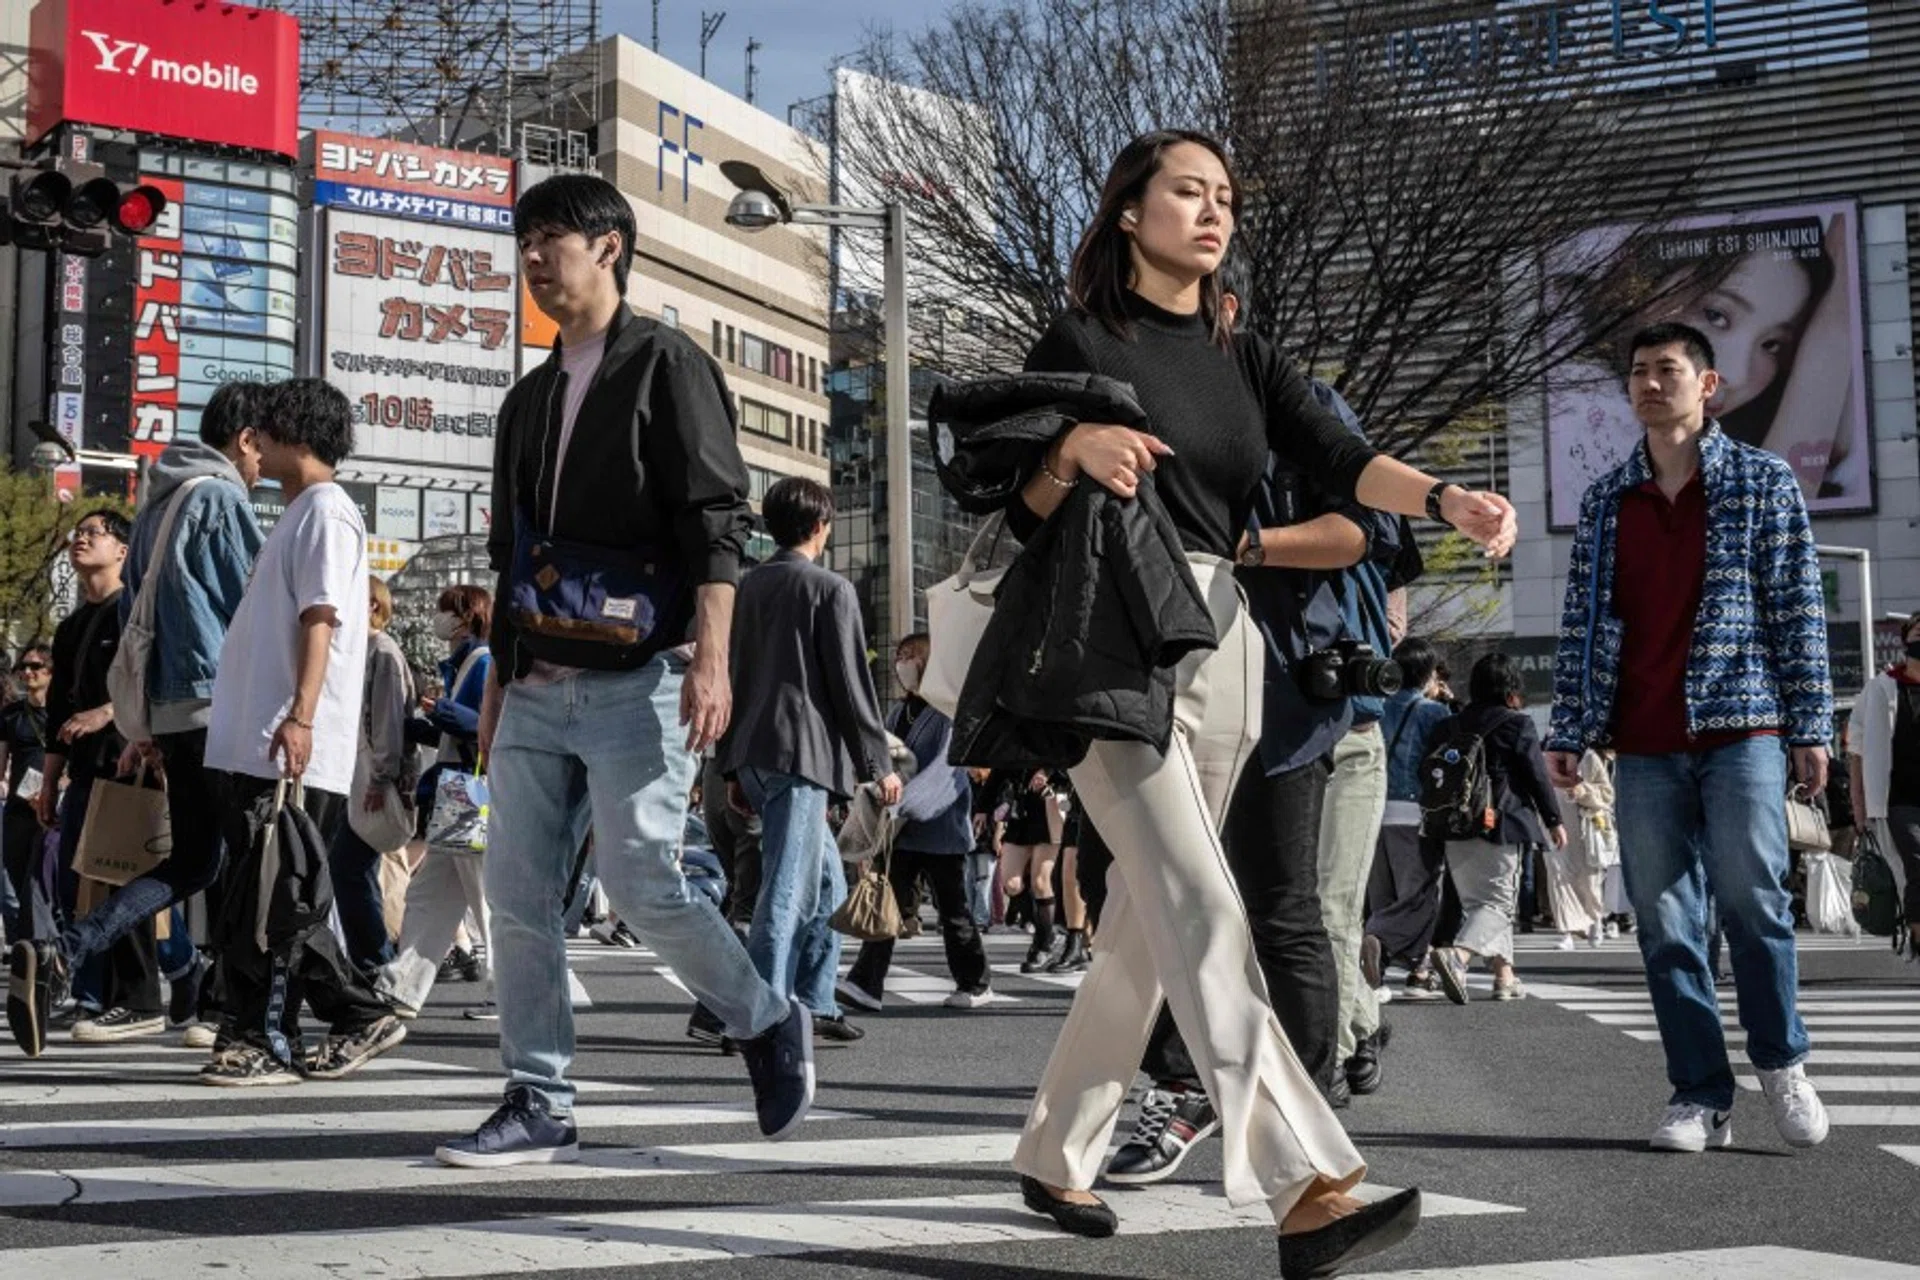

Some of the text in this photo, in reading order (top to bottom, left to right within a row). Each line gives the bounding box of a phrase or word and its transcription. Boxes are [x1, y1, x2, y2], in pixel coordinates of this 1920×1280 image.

[321, 142, 510, 195] ヨドバシカメラ
[345, 187, 513, 226] マルチメディア新宿東口
[334, 230, 512, 292] ヨドバシ
[1746, 226, 1820, 251] SHINJUKU
[379, 296, 512, 351] カメラ
[203, 364, 264, 383] Google
